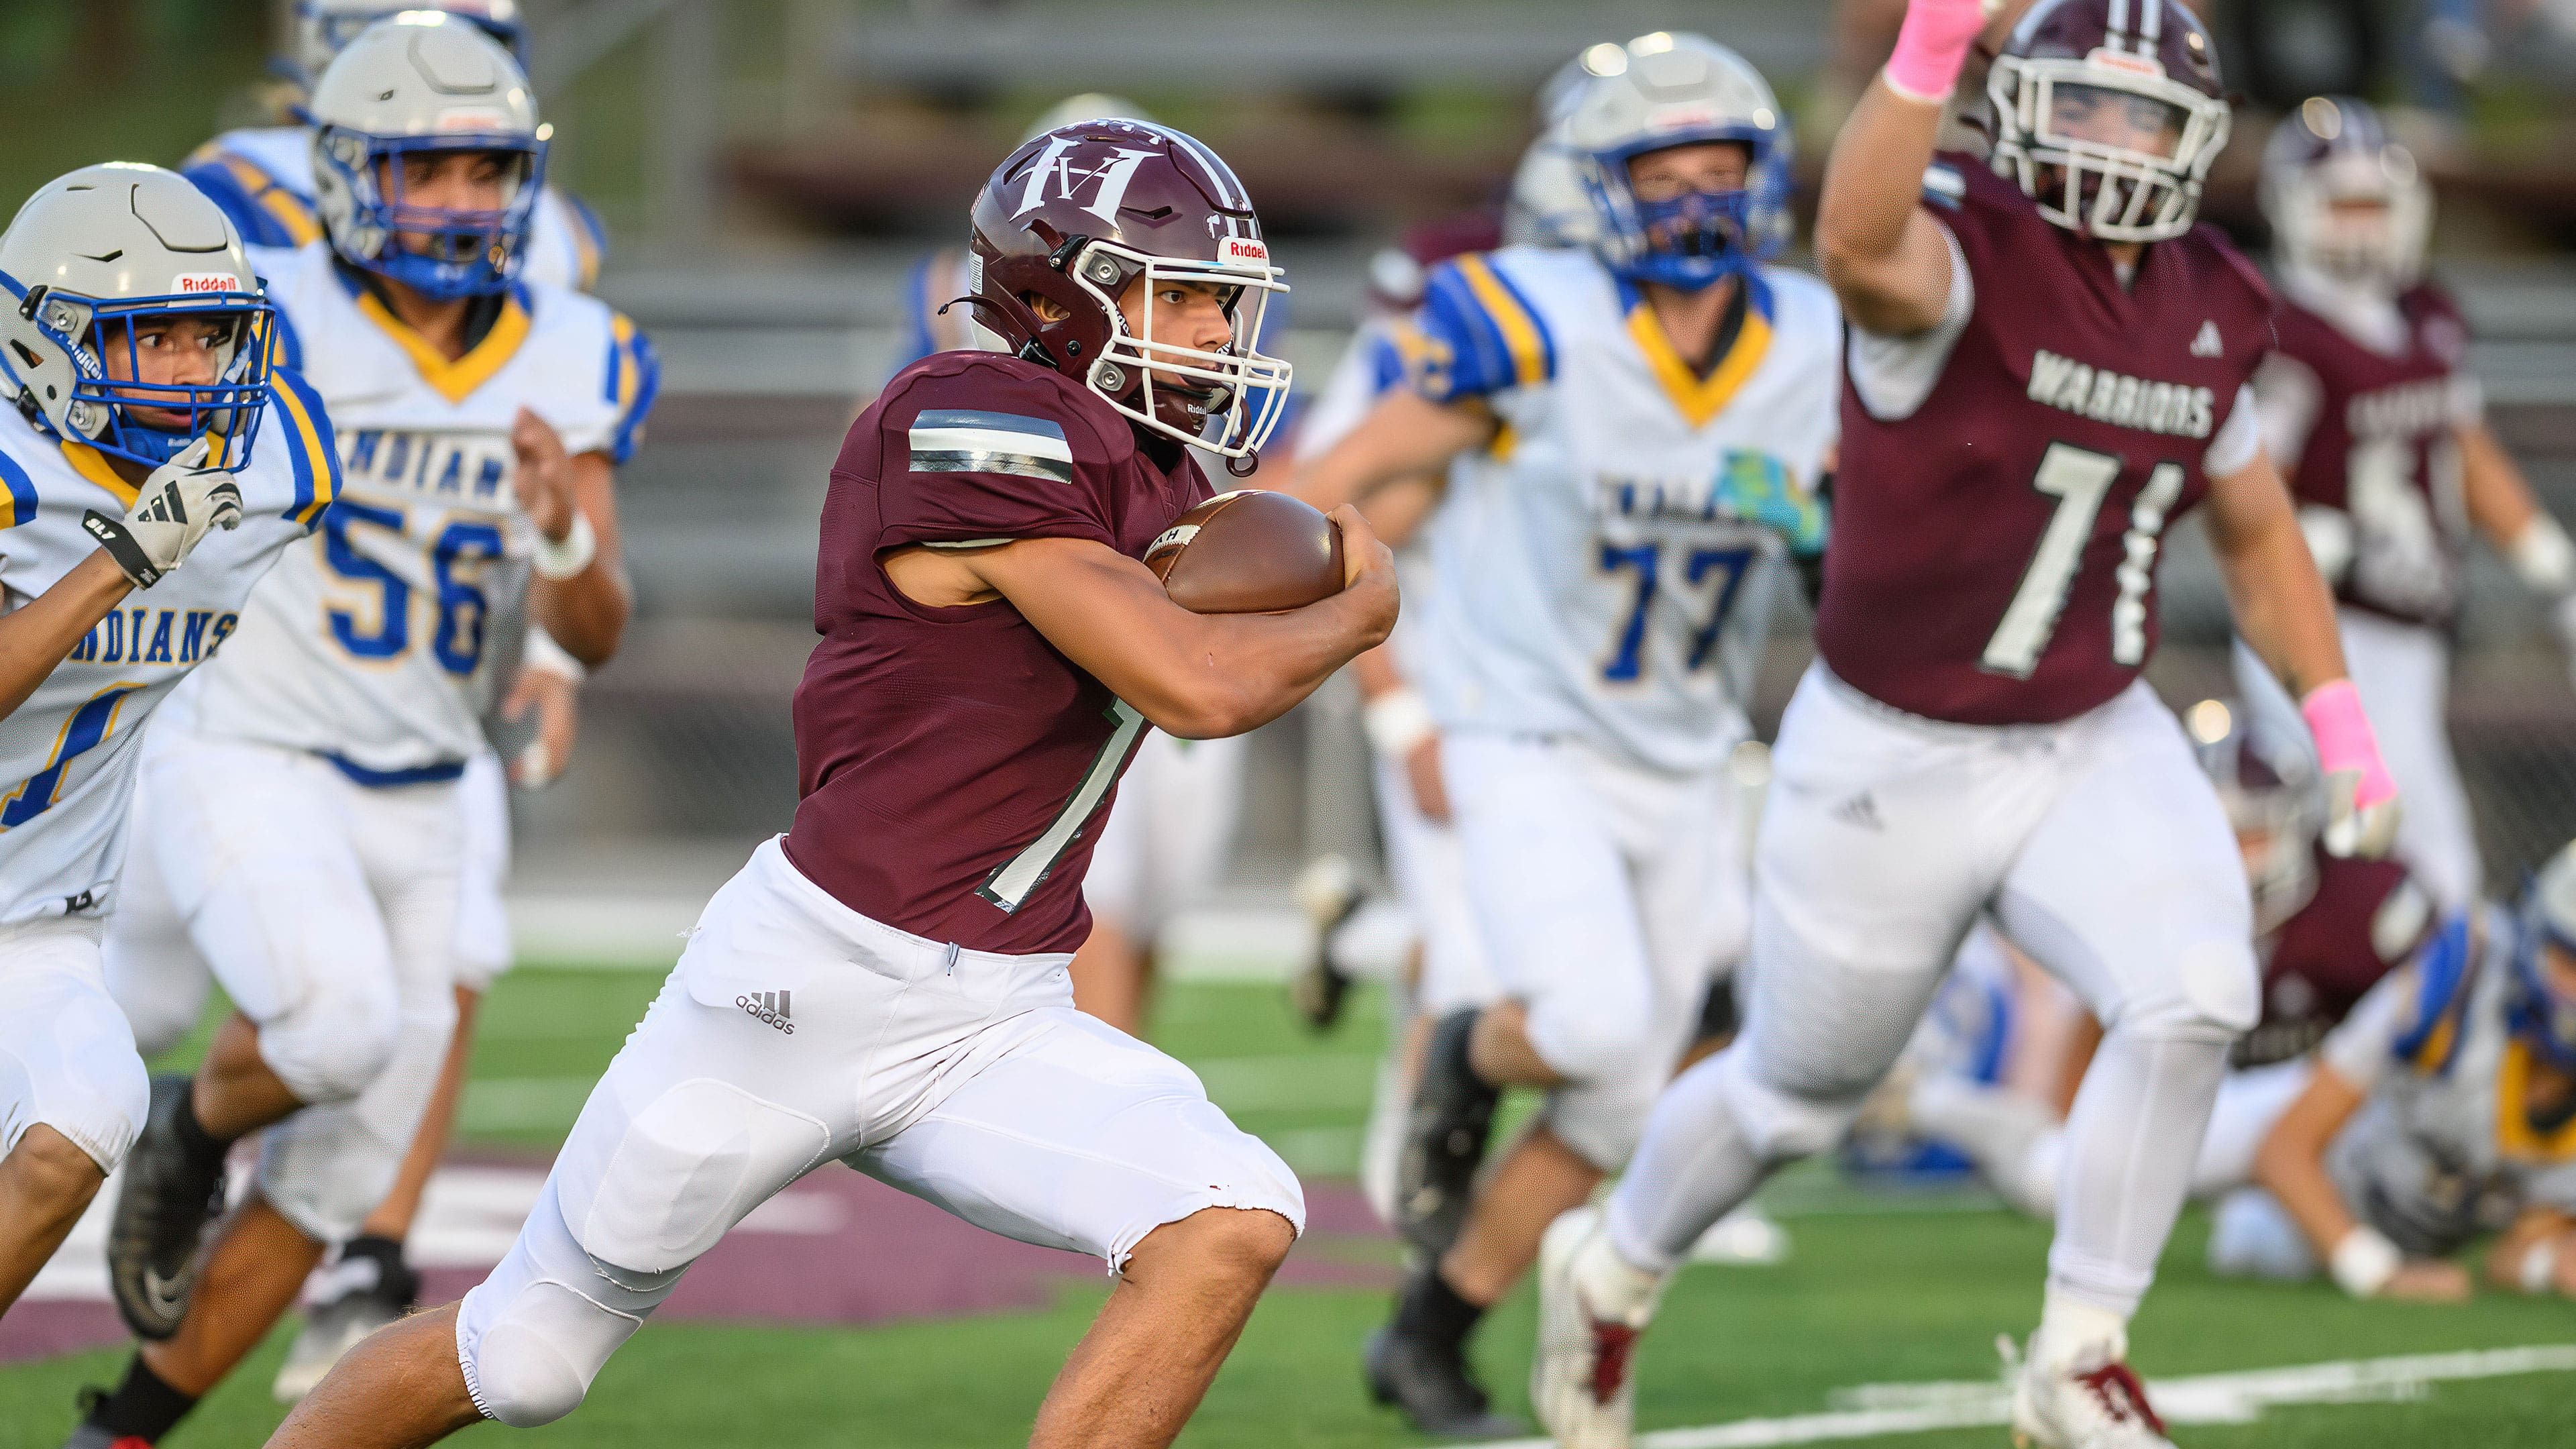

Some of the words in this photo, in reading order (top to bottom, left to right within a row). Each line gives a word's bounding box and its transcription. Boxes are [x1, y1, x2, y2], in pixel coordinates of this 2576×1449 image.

[2027, 348, 2214, 439] WARRIORS
[315, 493, 510, 681] 56
[1600, 542, 1756, 683] 77
[1978, 440, 2187, 680] 71
[735, 995, 795, 1035] adidas
